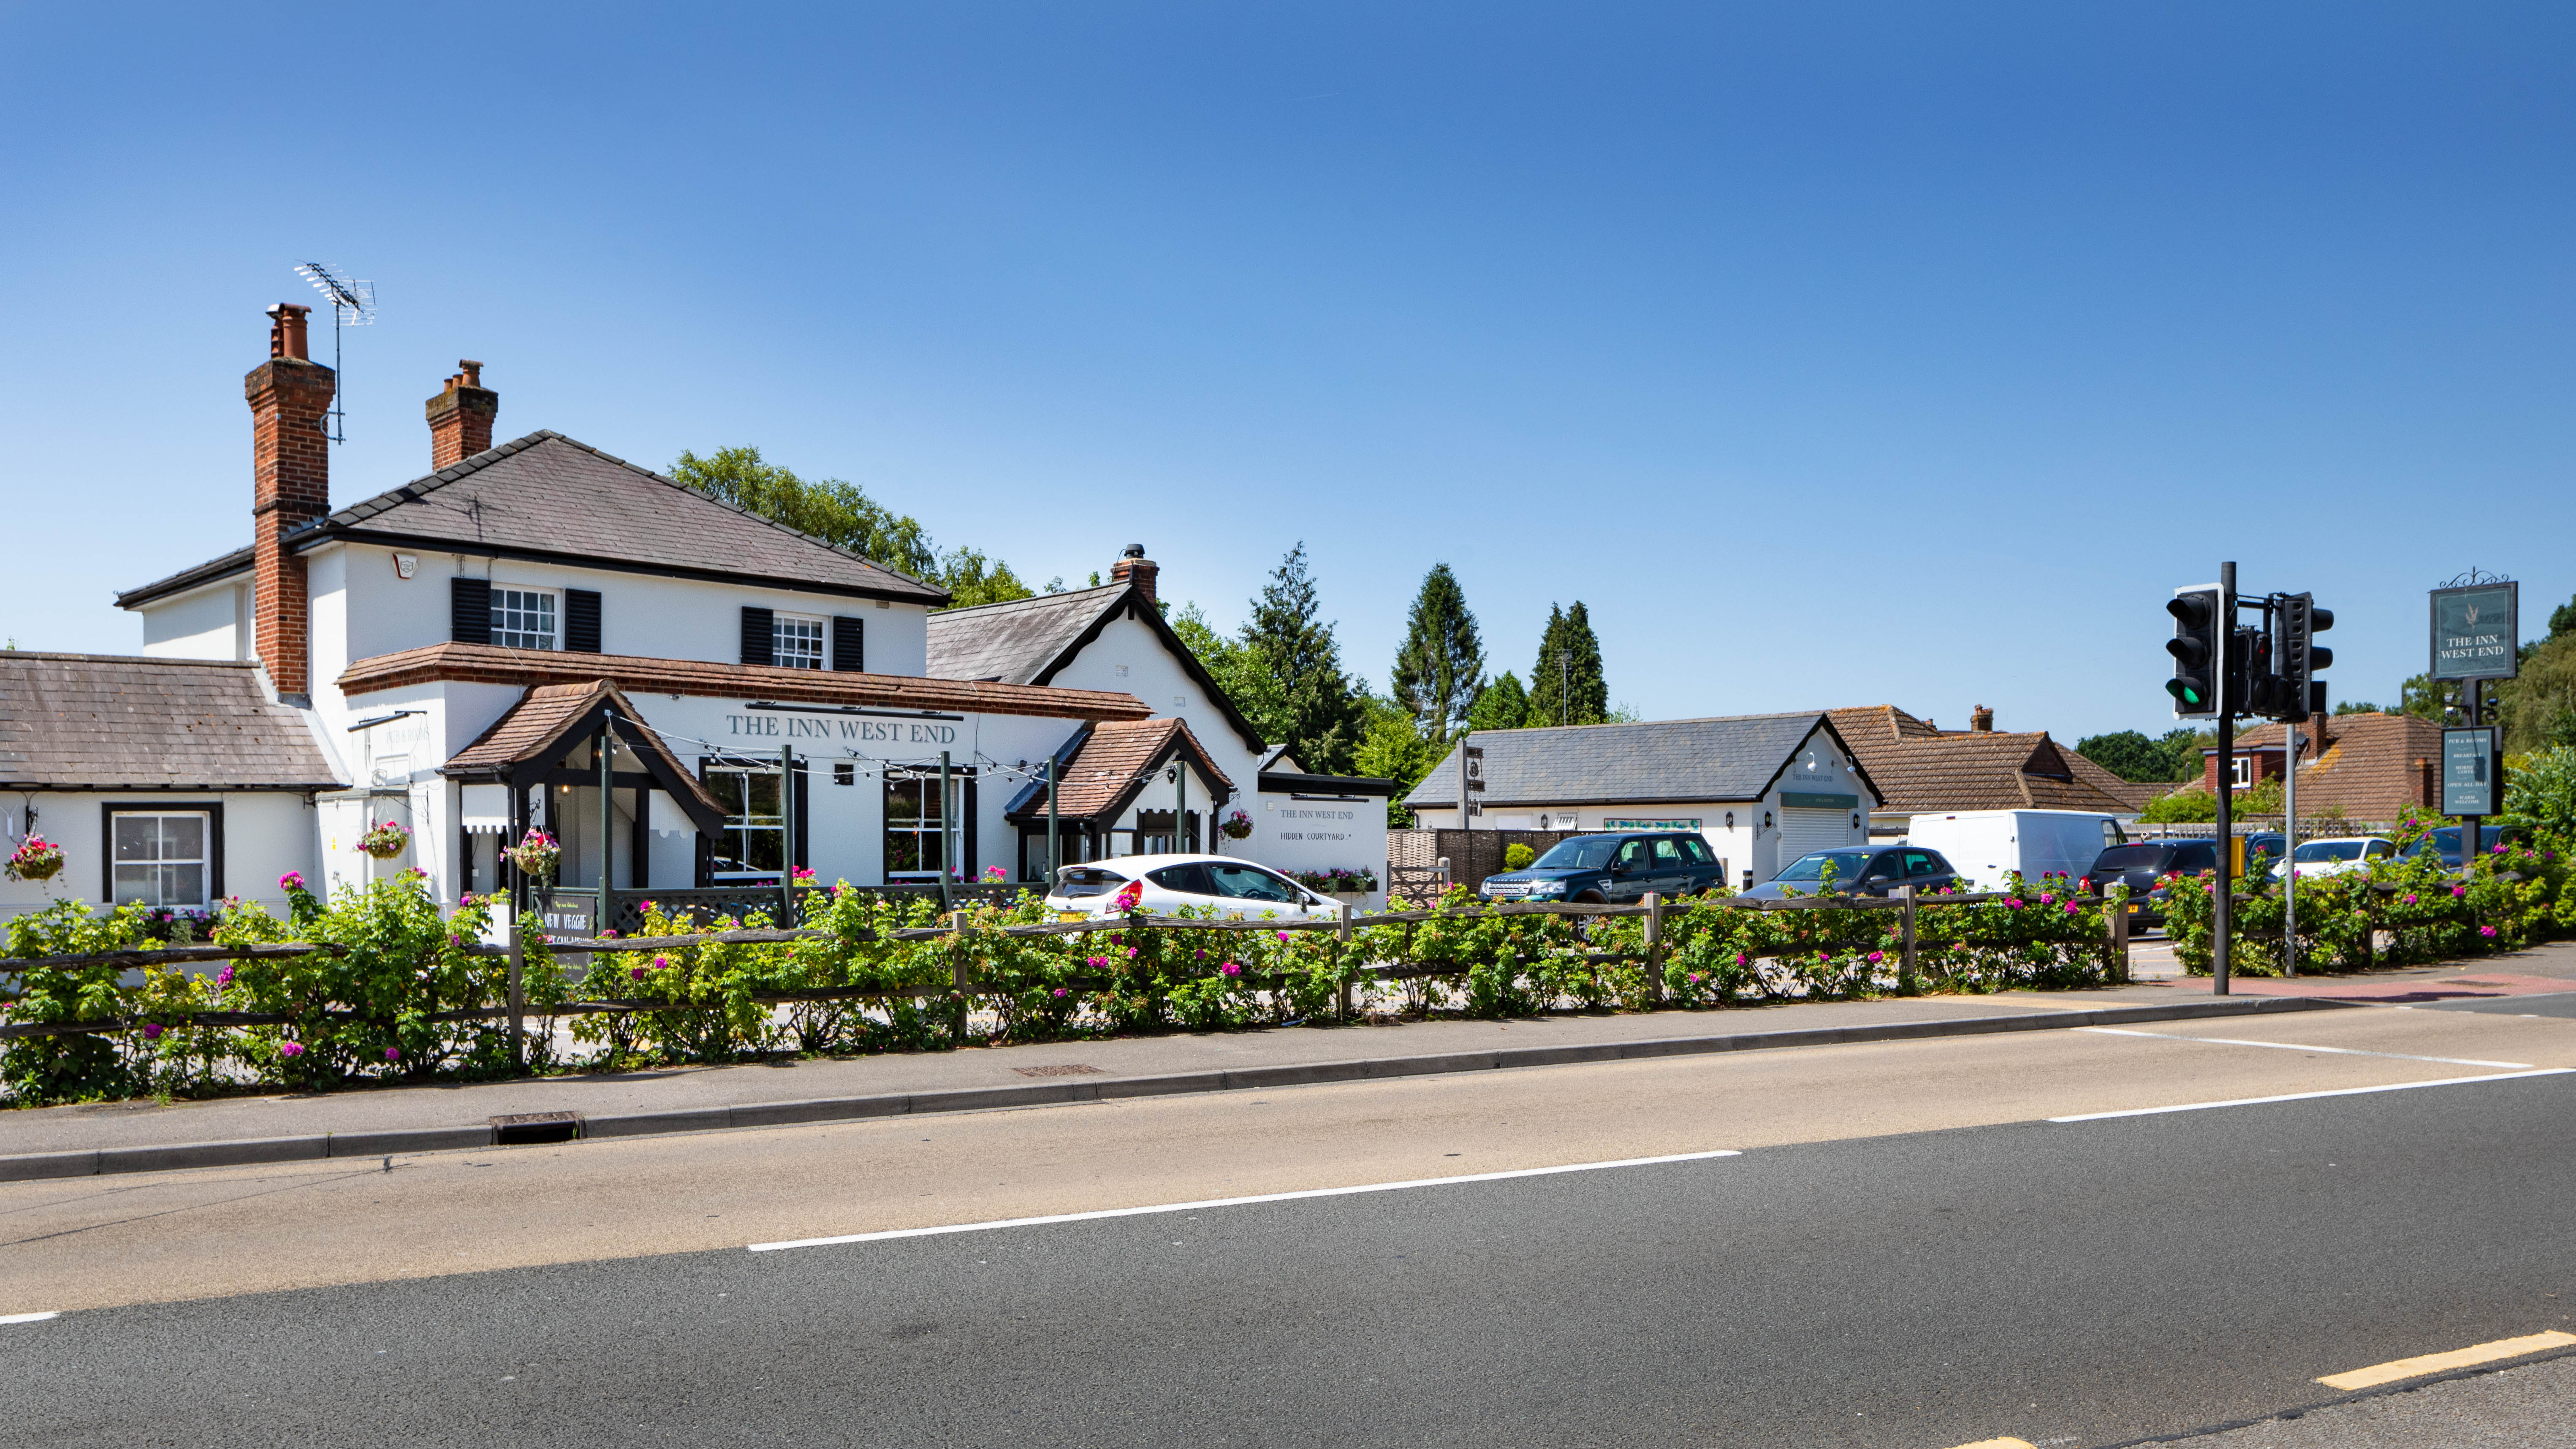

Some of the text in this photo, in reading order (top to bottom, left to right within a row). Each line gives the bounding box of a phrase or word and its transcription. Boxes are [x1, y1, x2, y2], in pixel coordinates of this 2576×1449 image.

[2446, 635, 2498, 647] THE INN
[2441, 646, 2504, 659] WEST END
[726, 715, 955, 744] THE INN WEST END
[386, 730, 400, 743] PUB
[402, 730, 406, 742] &
[1281, 810, 1353, 819] THE INN WEST END
[1280, 832, 1344, 841] HIDDEN COURTYARD
[544, 913, 559, 929] NEW
[564, 914, 587, 930] VEGGIE
